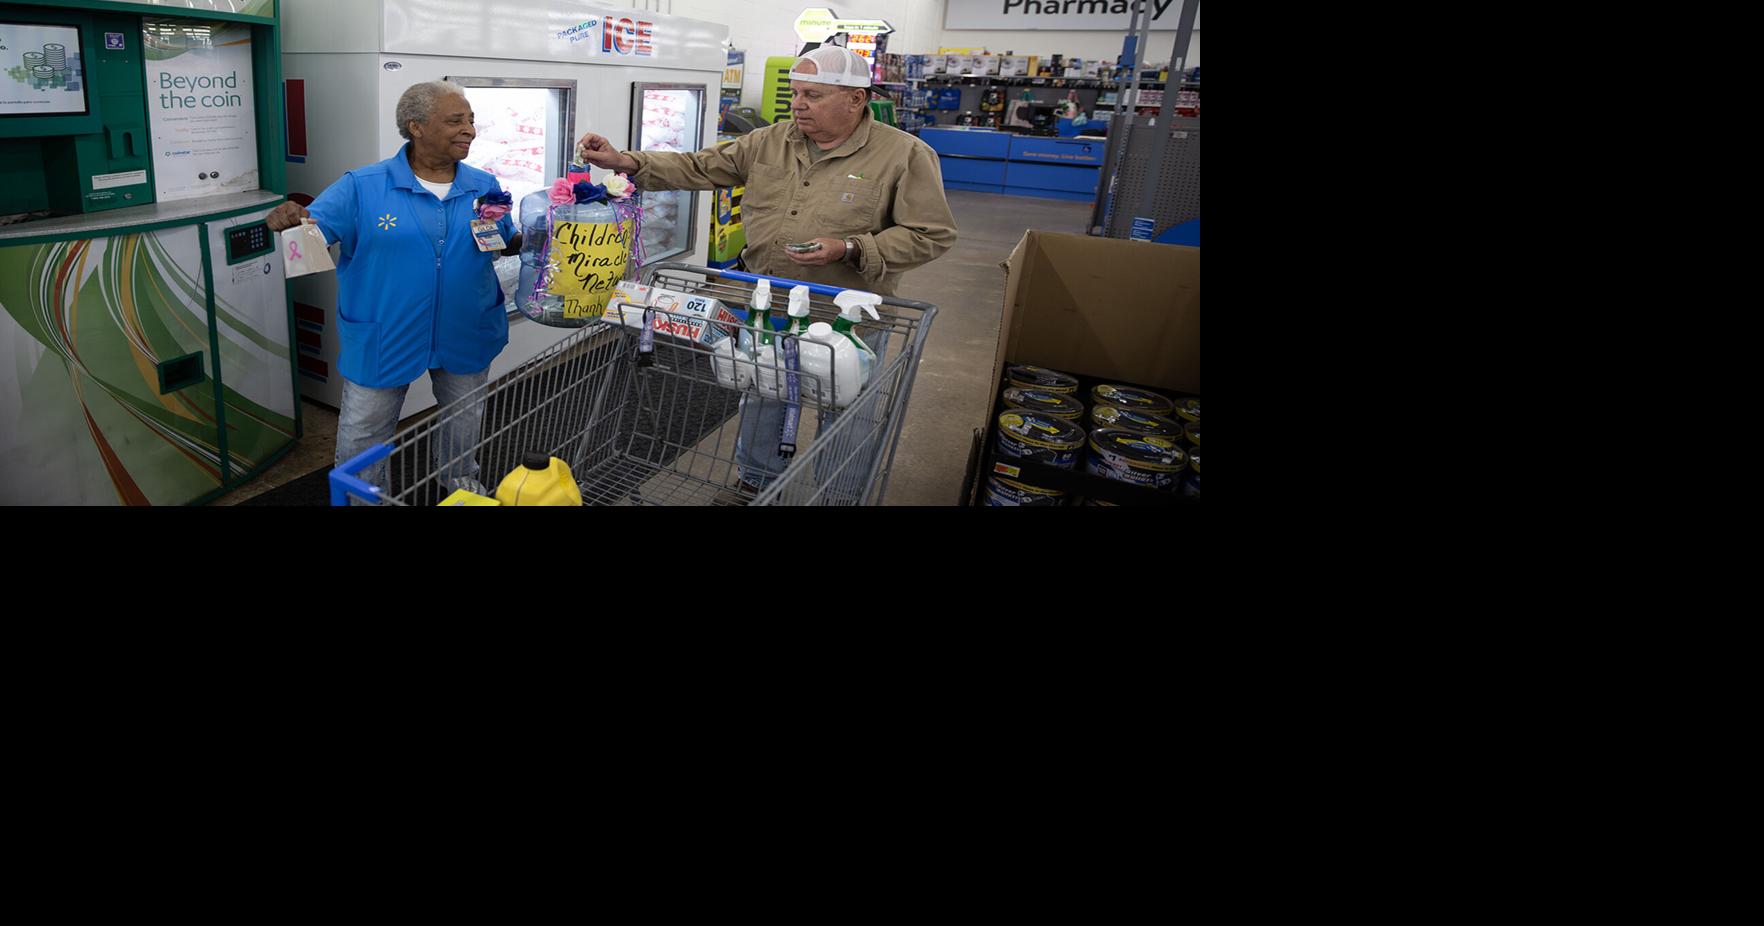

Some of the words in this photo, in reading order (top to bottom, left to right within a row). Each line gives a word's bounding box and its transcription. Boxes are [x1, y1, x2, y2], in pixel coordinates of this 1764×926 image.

[557, 19, 598, 40] PACKAGED
[800, 19, 832, 27] minute
[569, 31, 590, 44] PURE
[602, 15, 653, 56] ICE
[159, 71, 237, 93] Beyond
[724, 68, 741, 83] ATM
[159, 91, 196, 109] the
[201, 91, 242, 107] coin
[687, 301, 706, 312] 120
